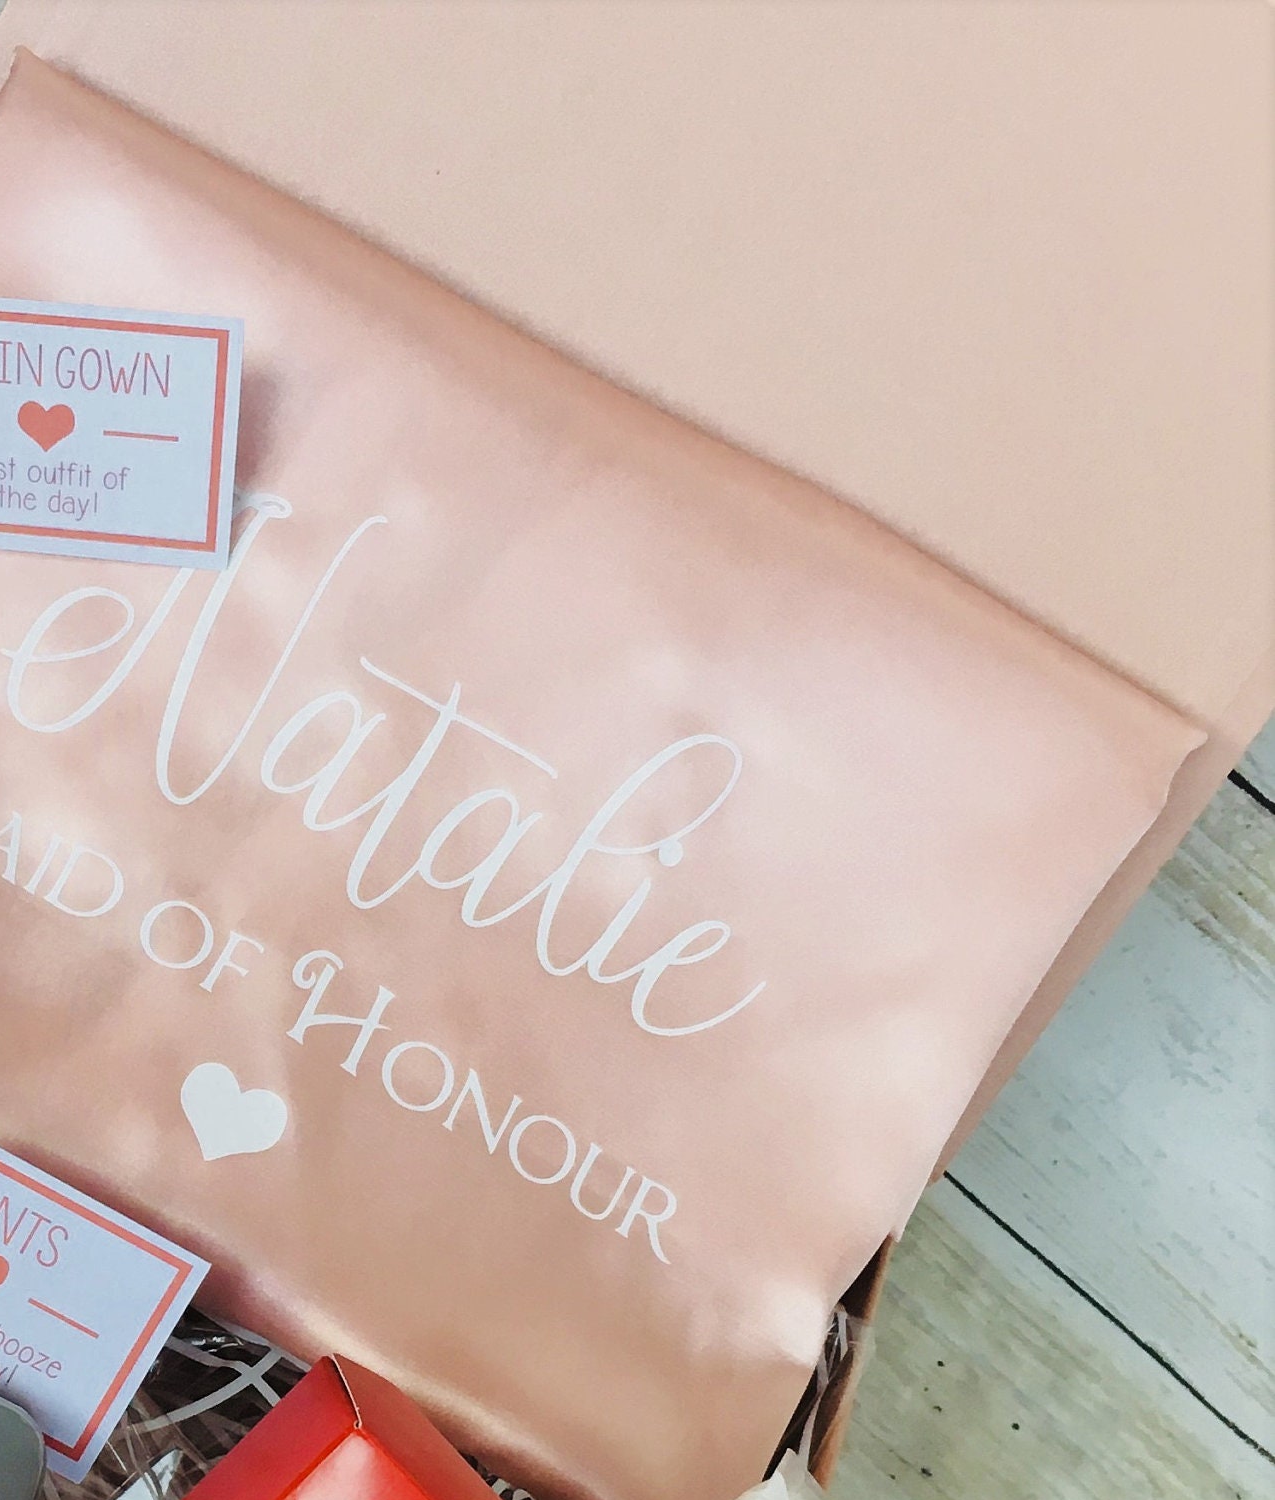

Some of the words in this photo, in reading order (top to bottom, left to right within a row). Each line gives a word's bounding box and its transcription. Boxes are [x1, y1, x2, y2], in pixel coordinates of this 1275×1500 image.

[55, 345, 171, 398] GOWN
[27, 463, 92, 488] outfit
[103, 467, 131, 491] of
[48, 492, 99, 521] day!
[0, 492, 767, 1037] Natalie
[138, 899, 267, 994] OF
[285, 948, 680, 1266] HONOUR
